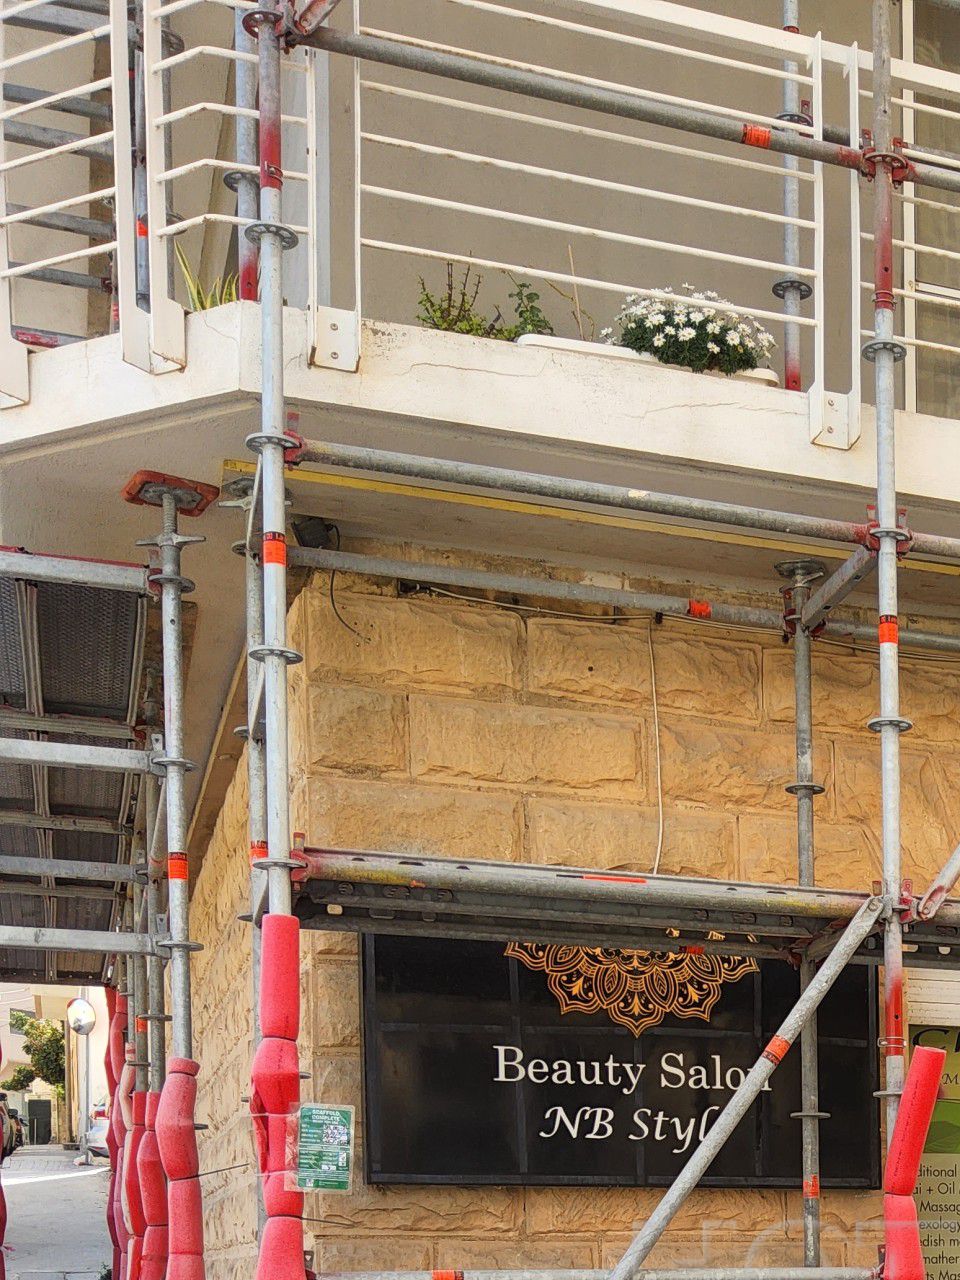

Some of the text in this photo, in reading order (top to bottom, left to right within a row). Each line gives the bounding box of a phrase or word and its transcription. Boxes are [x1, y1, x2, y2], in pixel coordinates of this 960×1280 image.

[493, 1045, 646, 1095] Beauty
[539, 1106, 719, 1154] NB Styl
[918, 1164, 957, 1178] ditional
[937, 1182, 955, 1195] Oil
[918, 1234, 946, 1247] edish
